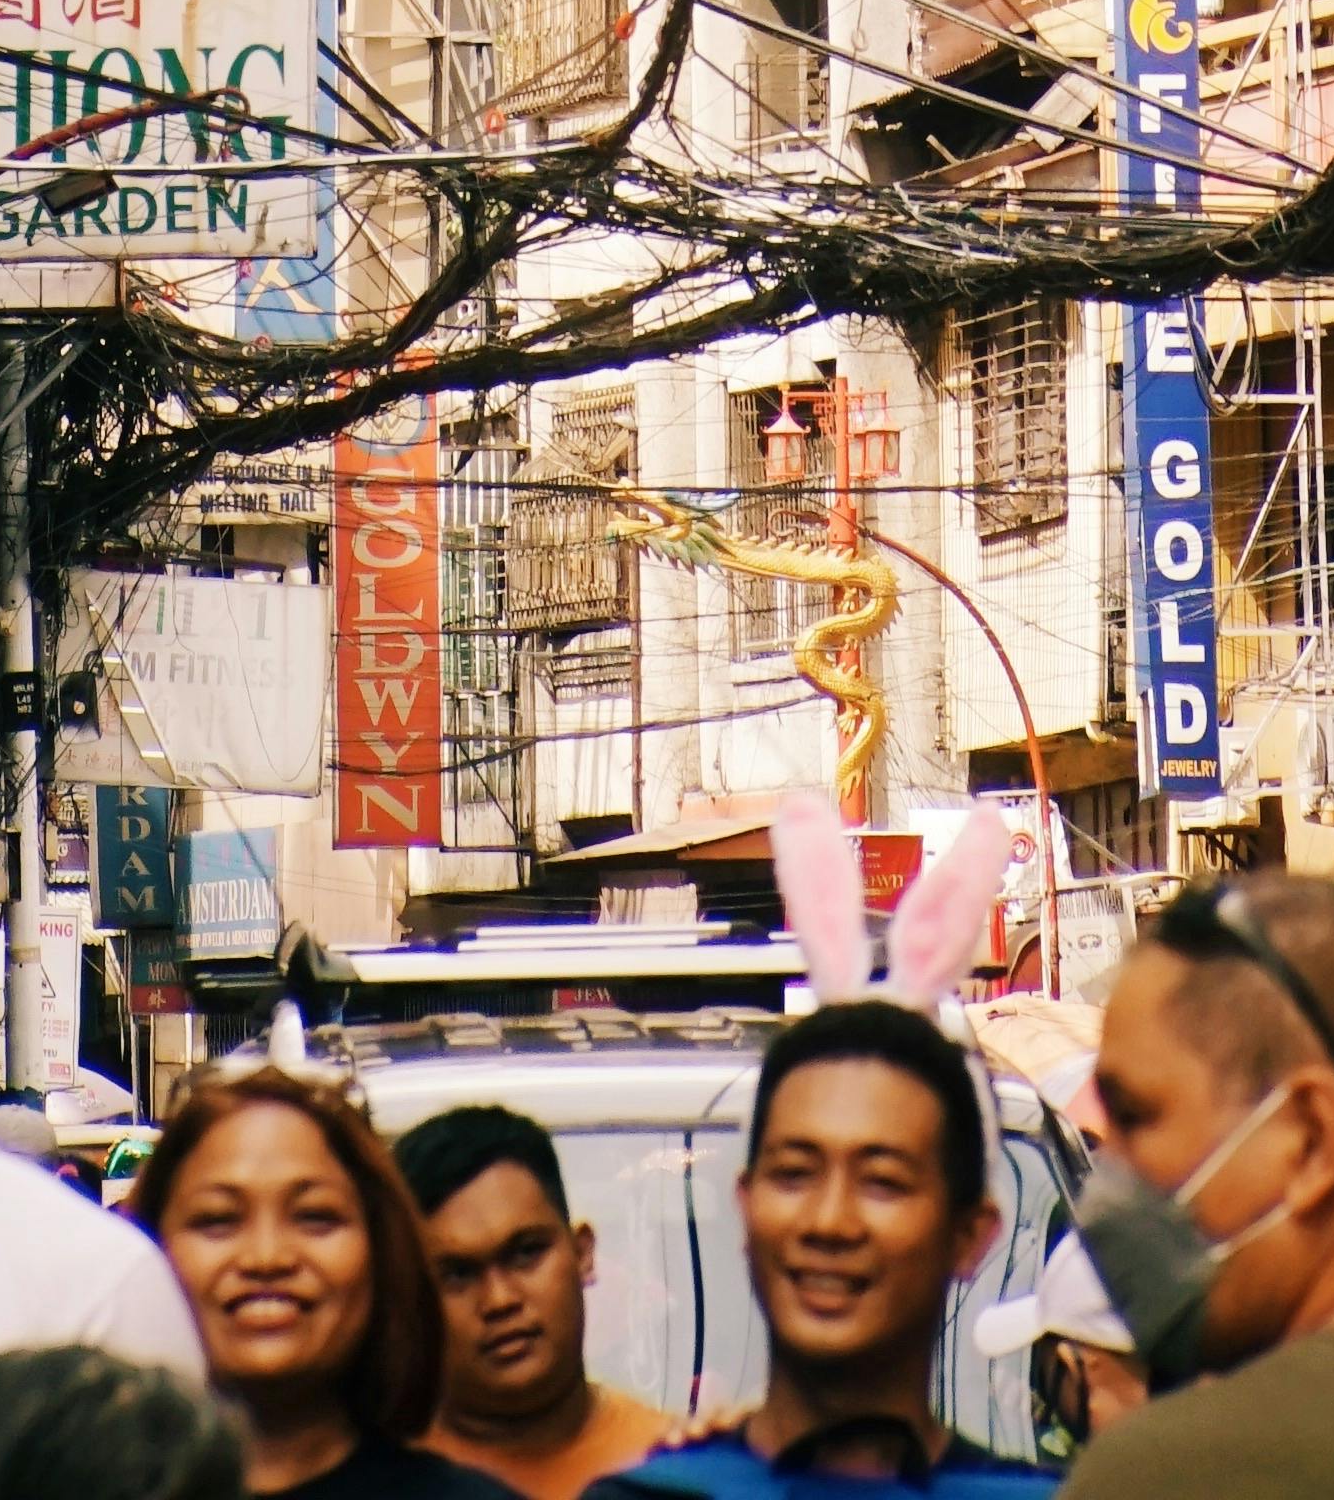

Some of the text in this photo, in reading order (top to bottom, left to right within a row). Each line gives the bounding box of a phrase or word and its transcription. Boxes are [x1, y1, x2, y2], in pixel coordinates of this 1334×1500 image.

[279, 491, 317, 513] HALL
[1149, 439, 1210, 745] GOLD
[349, 467, 425, 834] GOLDWYN
[1160, 759, 1218, 780] JEWELRY
[176, 876, 276, 926] AMSTERDAM
